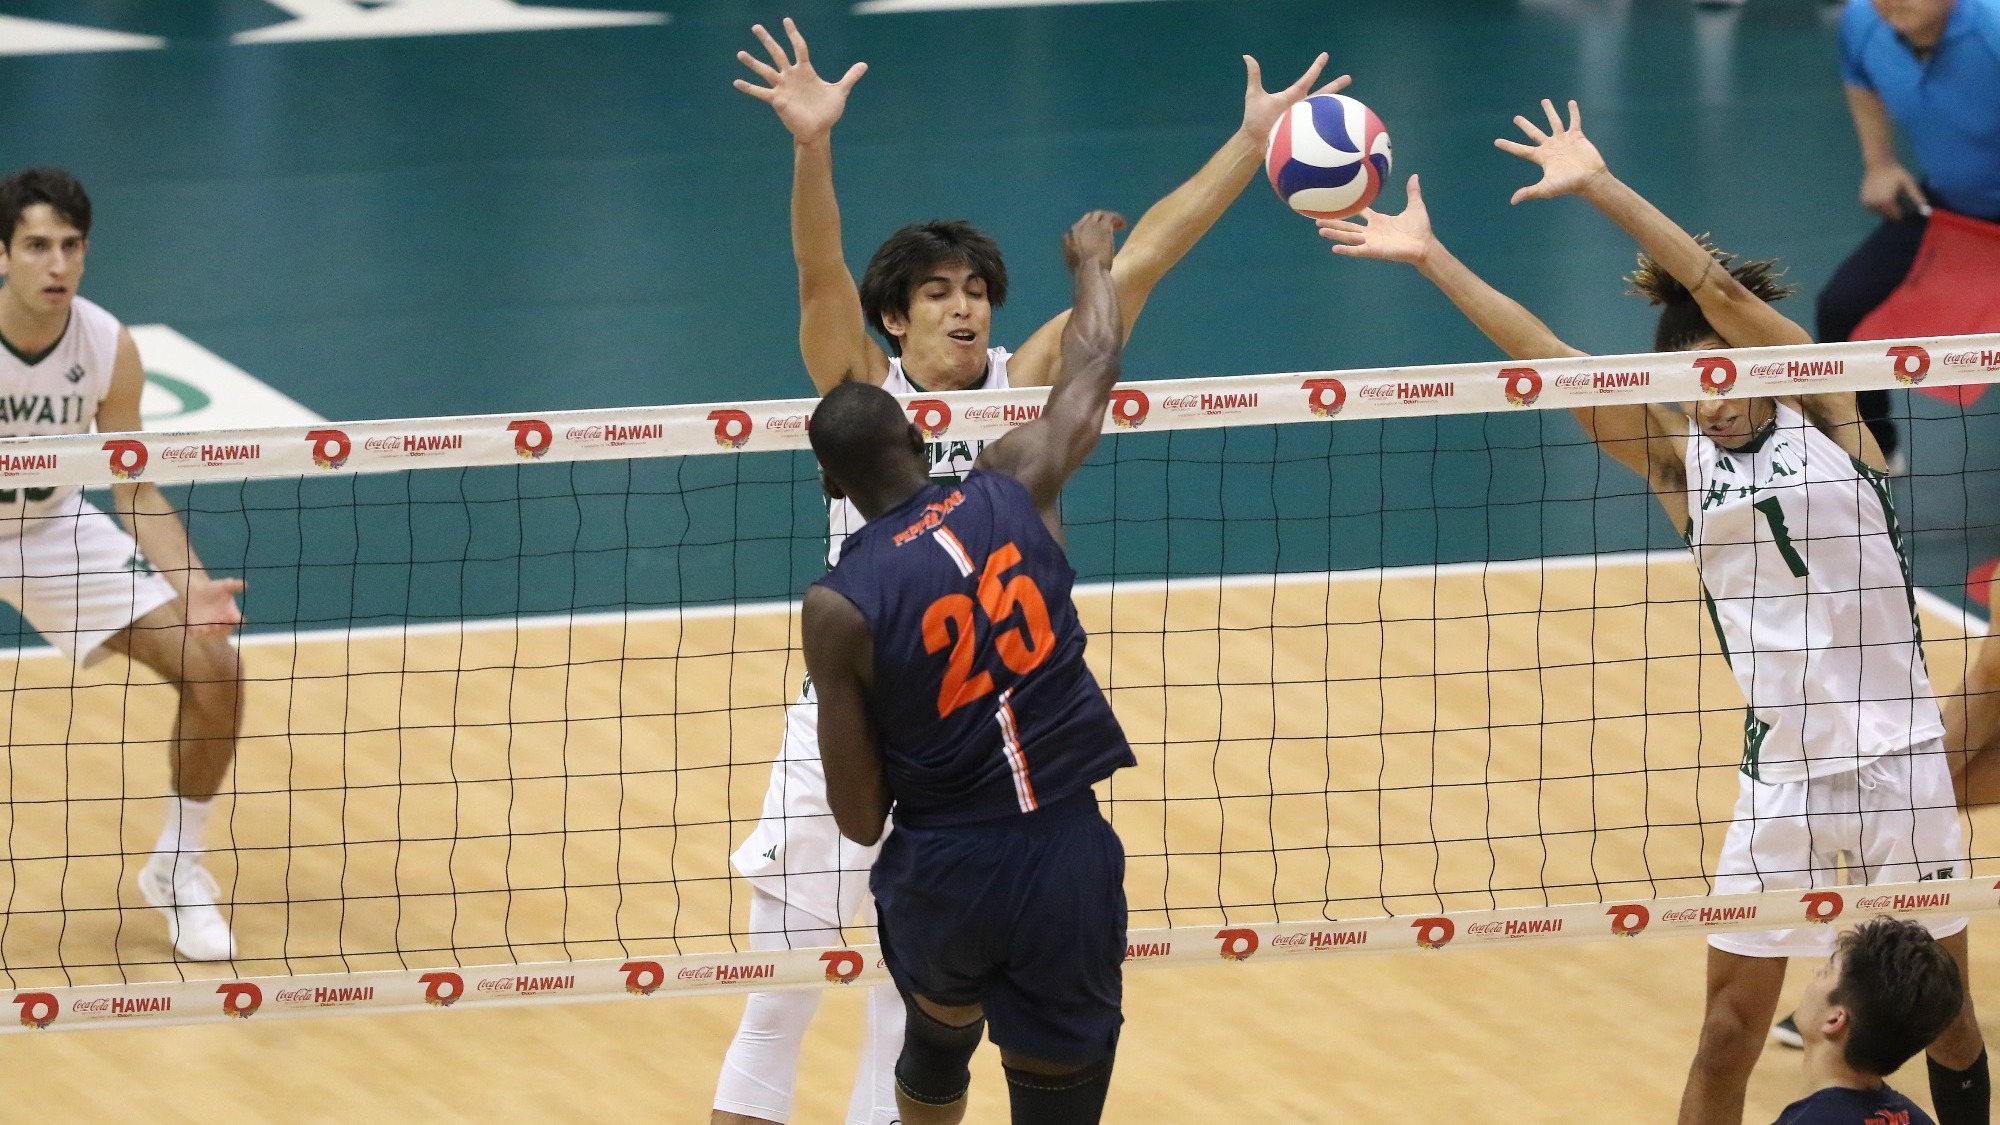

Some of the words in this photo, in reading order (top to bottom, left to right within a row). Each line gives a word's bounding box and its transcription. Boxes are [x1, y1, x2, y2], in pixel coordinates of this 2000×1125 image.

[1787, 360, 1844, 377] HAWAII
[1593, 371, 1650, 388] HAWAII
[1397, 382, 1454, 399] HAWAII
[0, 395, 84, 424] AWAII
[1200, 392, 1258, 410] HAWAII
[1003, 404, 1041, 421] HAW
[605, 424, 663, 440] HAWAII
[403, 434, 462, 451] HAWAII
[201, 444, 260, 461] HAWAII
[1752, 495, 1810, 578] 1
[921, 541, 1056, 719] 25
[1893, 893, 1951, 910] HAWAII
[1699, 906, 1757, 922] HAWAII
[1505, 918, 1563, 935] HAWAII
[1309, 930, 1368, 947] HAWAII
[1125, 942, 1171, 958] AWAII
[715, 964, 775, 980] HAWAII
[515, 975, 575, 991] HAWAII
[314, 986, 374, 1003] HAWAII
[111, 996, 171, 1014] HAWAII
